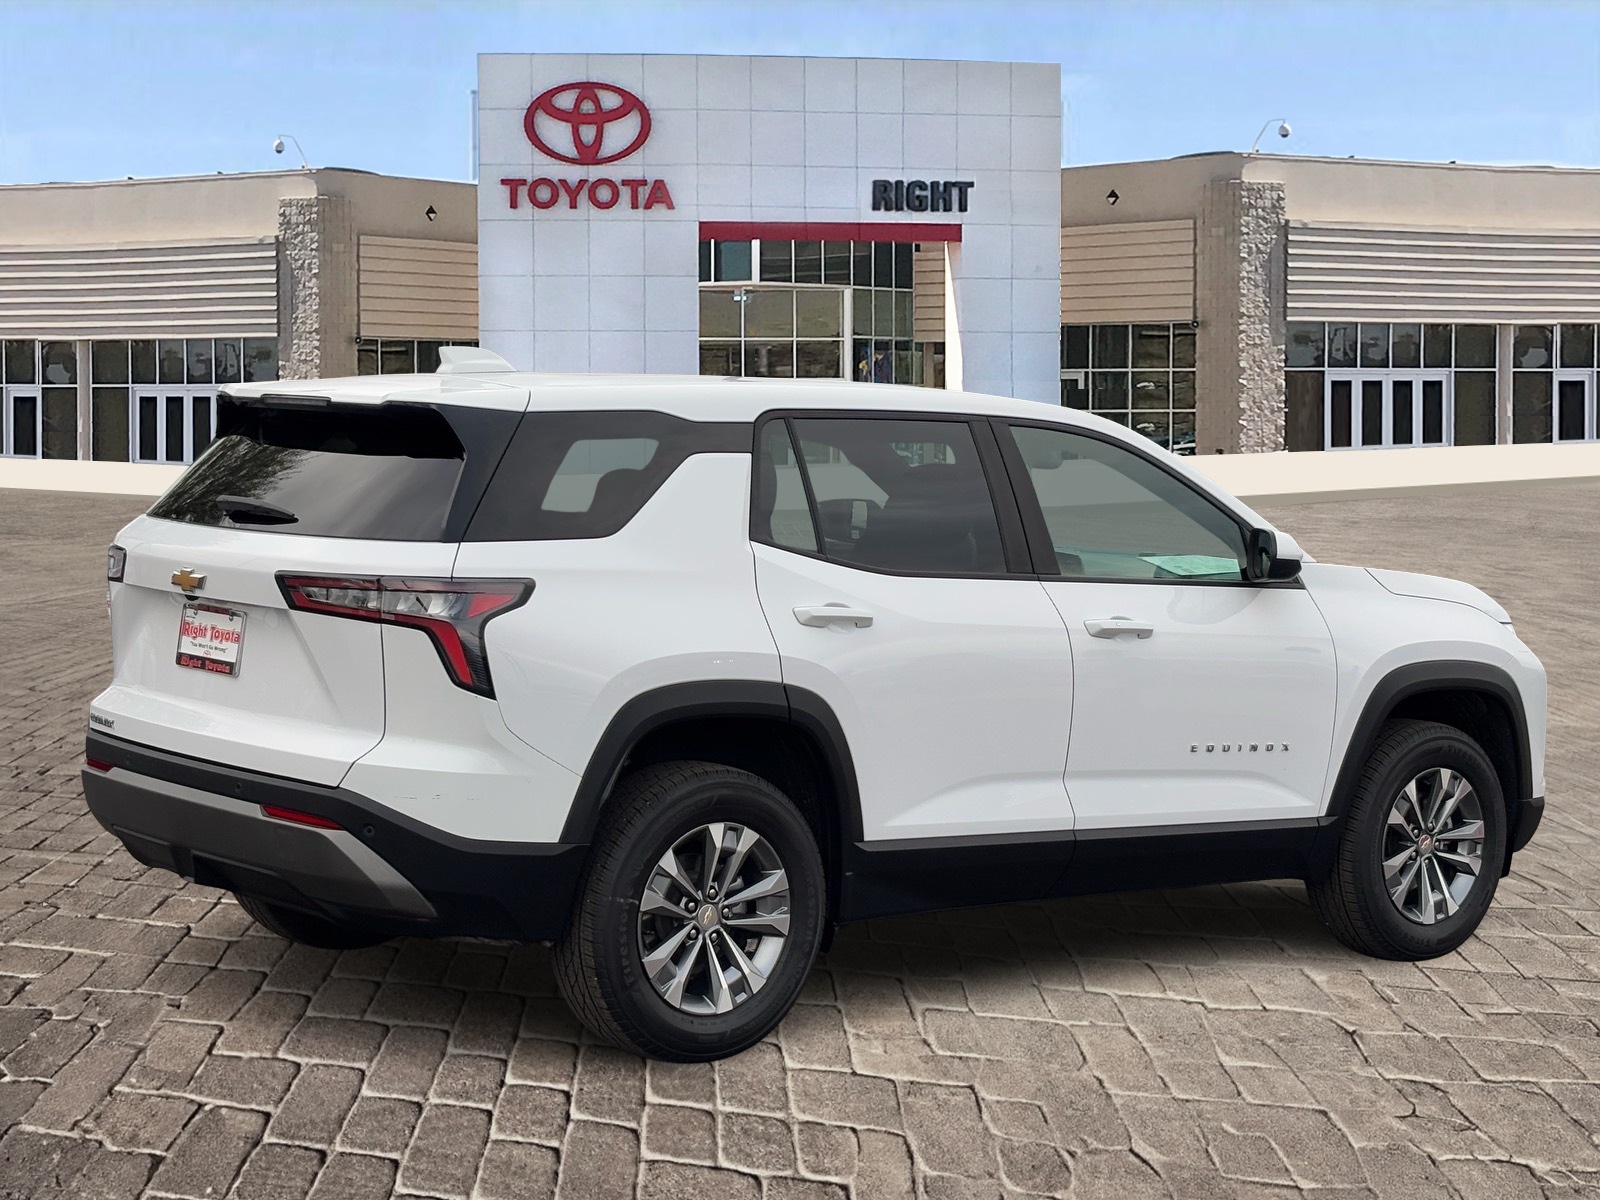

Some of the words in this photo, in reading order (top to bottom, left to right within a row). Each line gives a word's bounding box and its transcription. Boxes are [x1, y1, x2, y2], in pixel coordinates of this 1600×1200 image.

[500, 177, 675, 210] TOYOTA
[872, 179, 975, 212] RIGHT
[182, 621, 208, 640] Right
[210, 625, 240, 644] Toyota
[180, 655, 202, 667] Right
[205, 661, 231, 673] Toyota
[1190, 743, 1289, 753] EQUINOX
